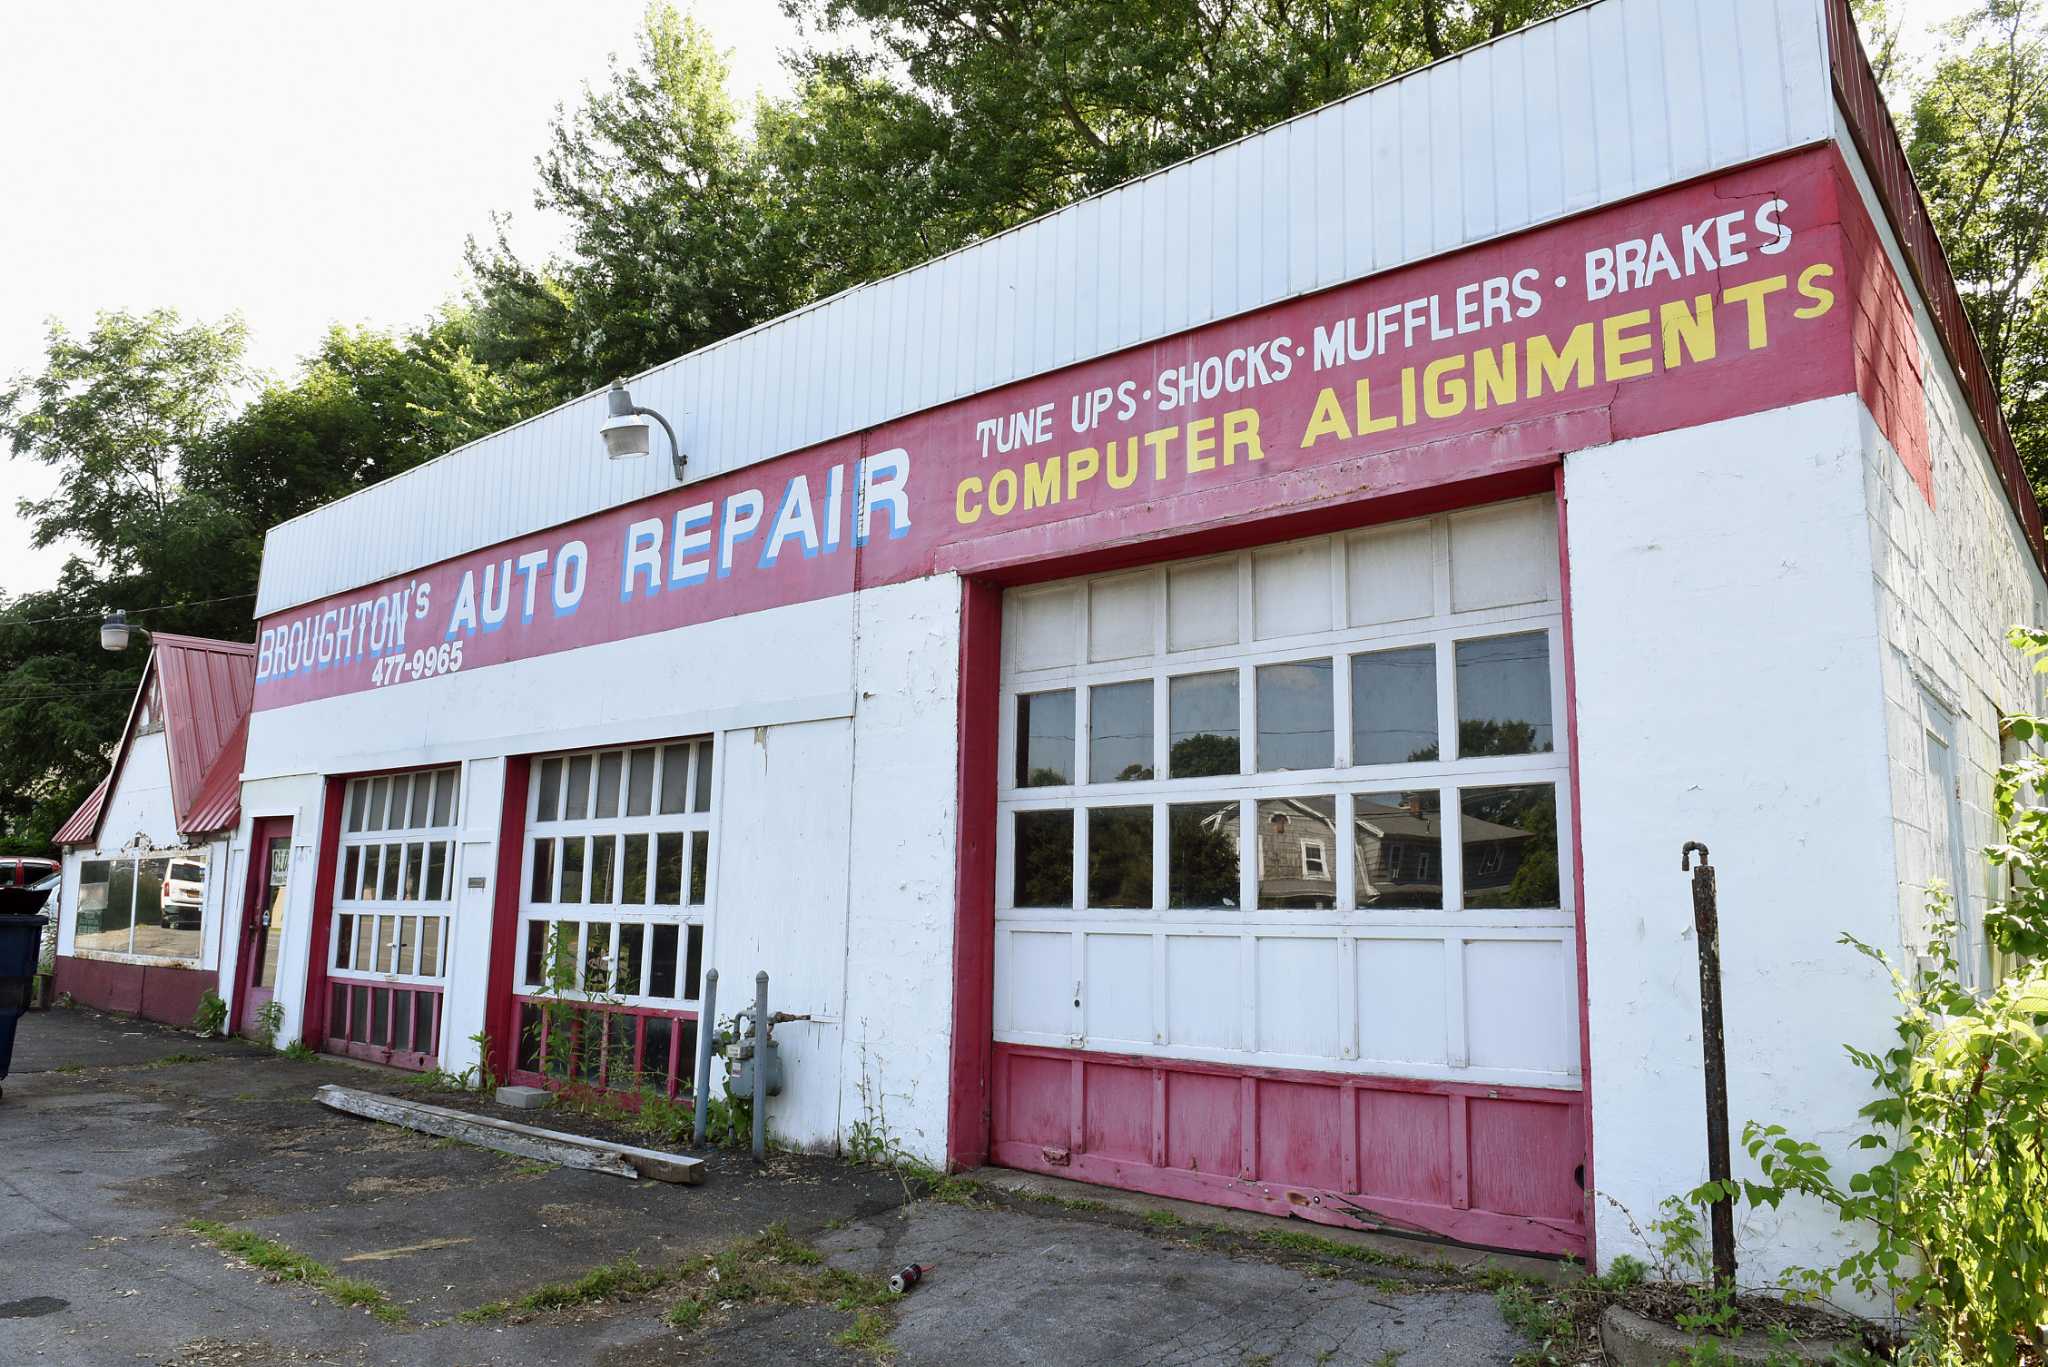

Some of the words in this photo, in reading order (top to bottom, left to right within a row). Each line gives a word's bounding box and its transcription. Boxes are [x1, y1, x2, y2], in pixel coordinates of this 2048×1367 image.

[955, 407, 1265, 524] COMPUTER
[1300, 263, 1835, 449] ALIGNMENTS
[976, 402, 1055, 458] TUNE
[1071, 380, 1136, 432] UPS
[1157, 336, 1292, 411] SHOCKS
[1312, 268, 1542, 372] MUFFLERS
[1585, 198, 1793, 301] BRAKES
[256, 579, 431, 683] BROUGHTON'S
[446, 540, 588, 640] AUTO
[621, 447, 911, 601] REPAIR
[371, 640, 464, 687] 477-9965
